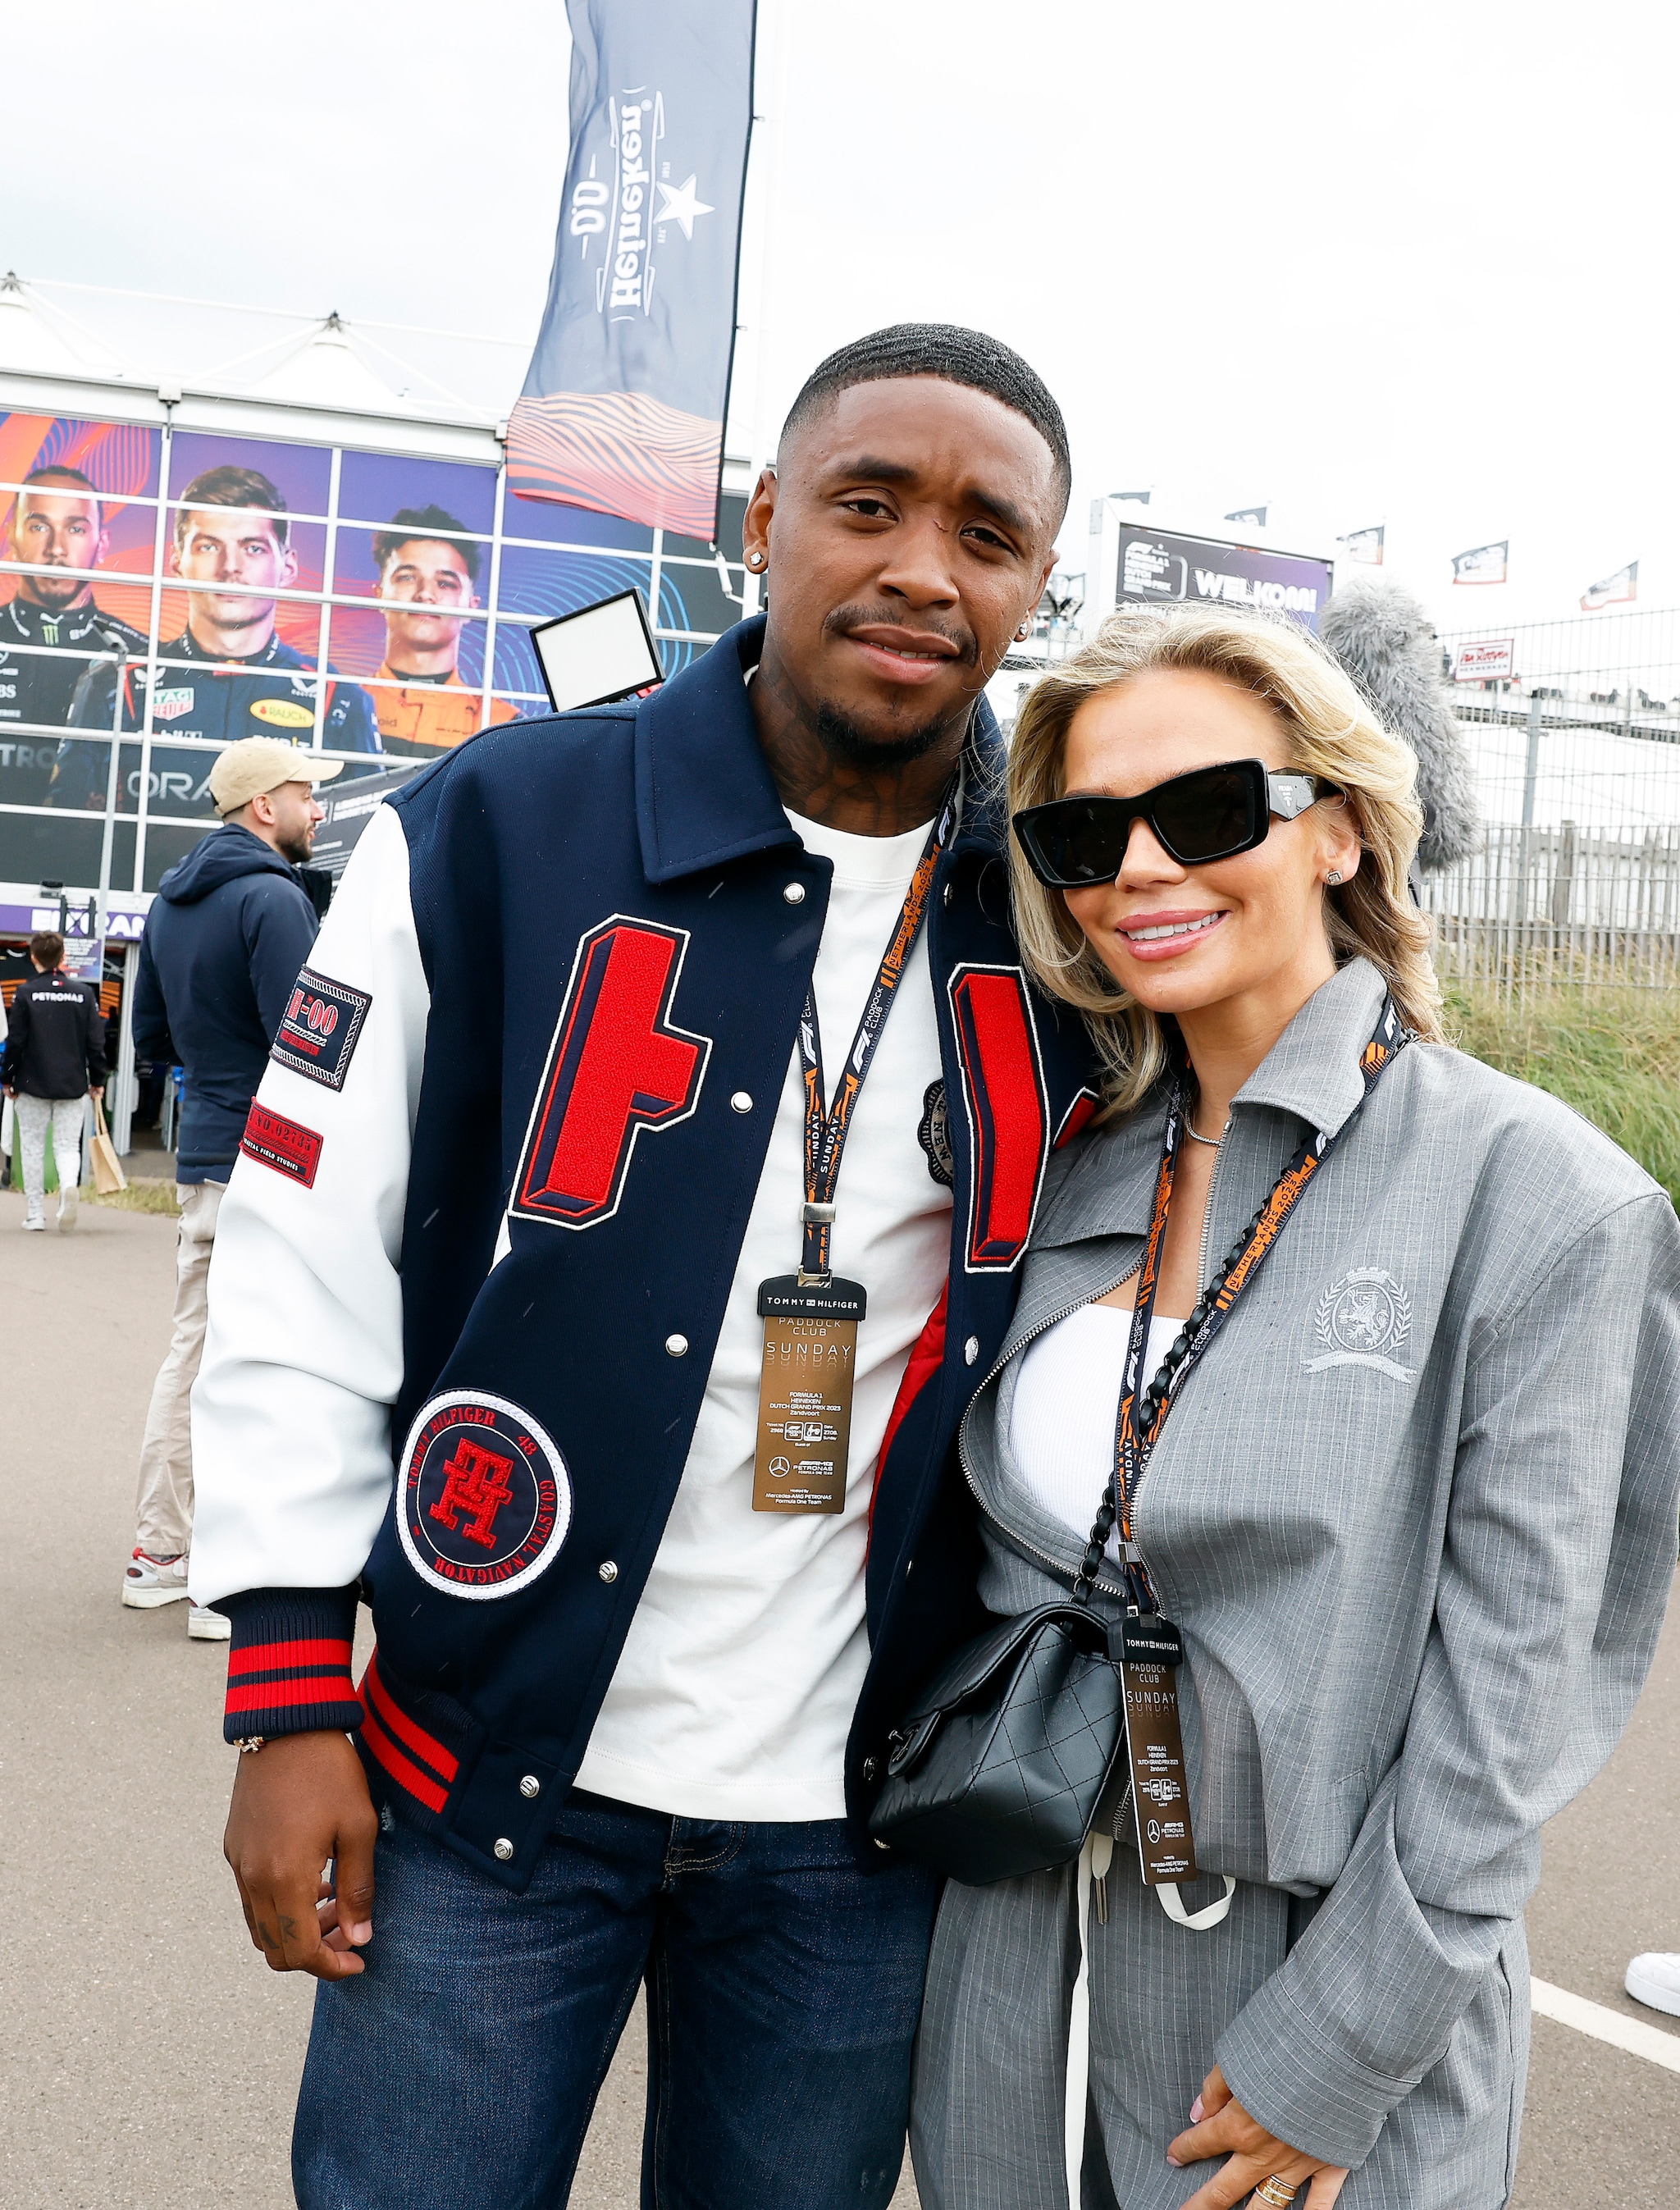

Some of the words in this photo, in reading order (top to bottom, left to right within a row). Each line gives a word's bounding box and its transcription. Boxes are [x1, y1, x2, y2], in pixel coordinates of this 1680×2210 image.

[889, 894, 921, 966] NETHERLANDS
[917, 865, 931, 892] 2023
[32, 992, 84, 1003] PETRONAS
[864, 986, 884, 1028] PADDOCK
[870, 1006, 883, 1029] CLUB
[820, 1117, 839, 1174] SUNDAY
[259, 1147, 276, 1160] FIELD
[276, 1155, 299, 1171] STUDIES
[1230, 1209, 1279, 1288] NETHERLANDS
[1276, 1179, 1298, 1208] 2023
[766, 1297, 805, 1306] TOMMY
[817, 1299, 858, 1309] HILFIGER
[778, 1317, 842, 1328] PADDOCK
[792, 1326, 827, 1336] CLUB
[1132, 1308, 1143, 1349] PADDOCK
[1135, 1324, 1144, 1348] CLUB
[1194, 1328, 1211, 1351] CLUB
[766, 1341, 851, 1356] SUNDAY
[429, 1407, 496, 1436] HILFIGER
[408, 1431, 431, 1489] TOMMY
[523, 1480, 556, 1555] COASTAL
[433, 1554, 527, 1584] NAVIGATOR
[1126, 1639, 1149, 1648] TOMMY
[1155, 1642, 1179, 1651] HILFIGER
[1130, 1663, 1166, 1673] PADDOCK
[1139, 1673, 1160, 1683] CLUB
[1126, 1690, 1176, 1704] SUNDAY
